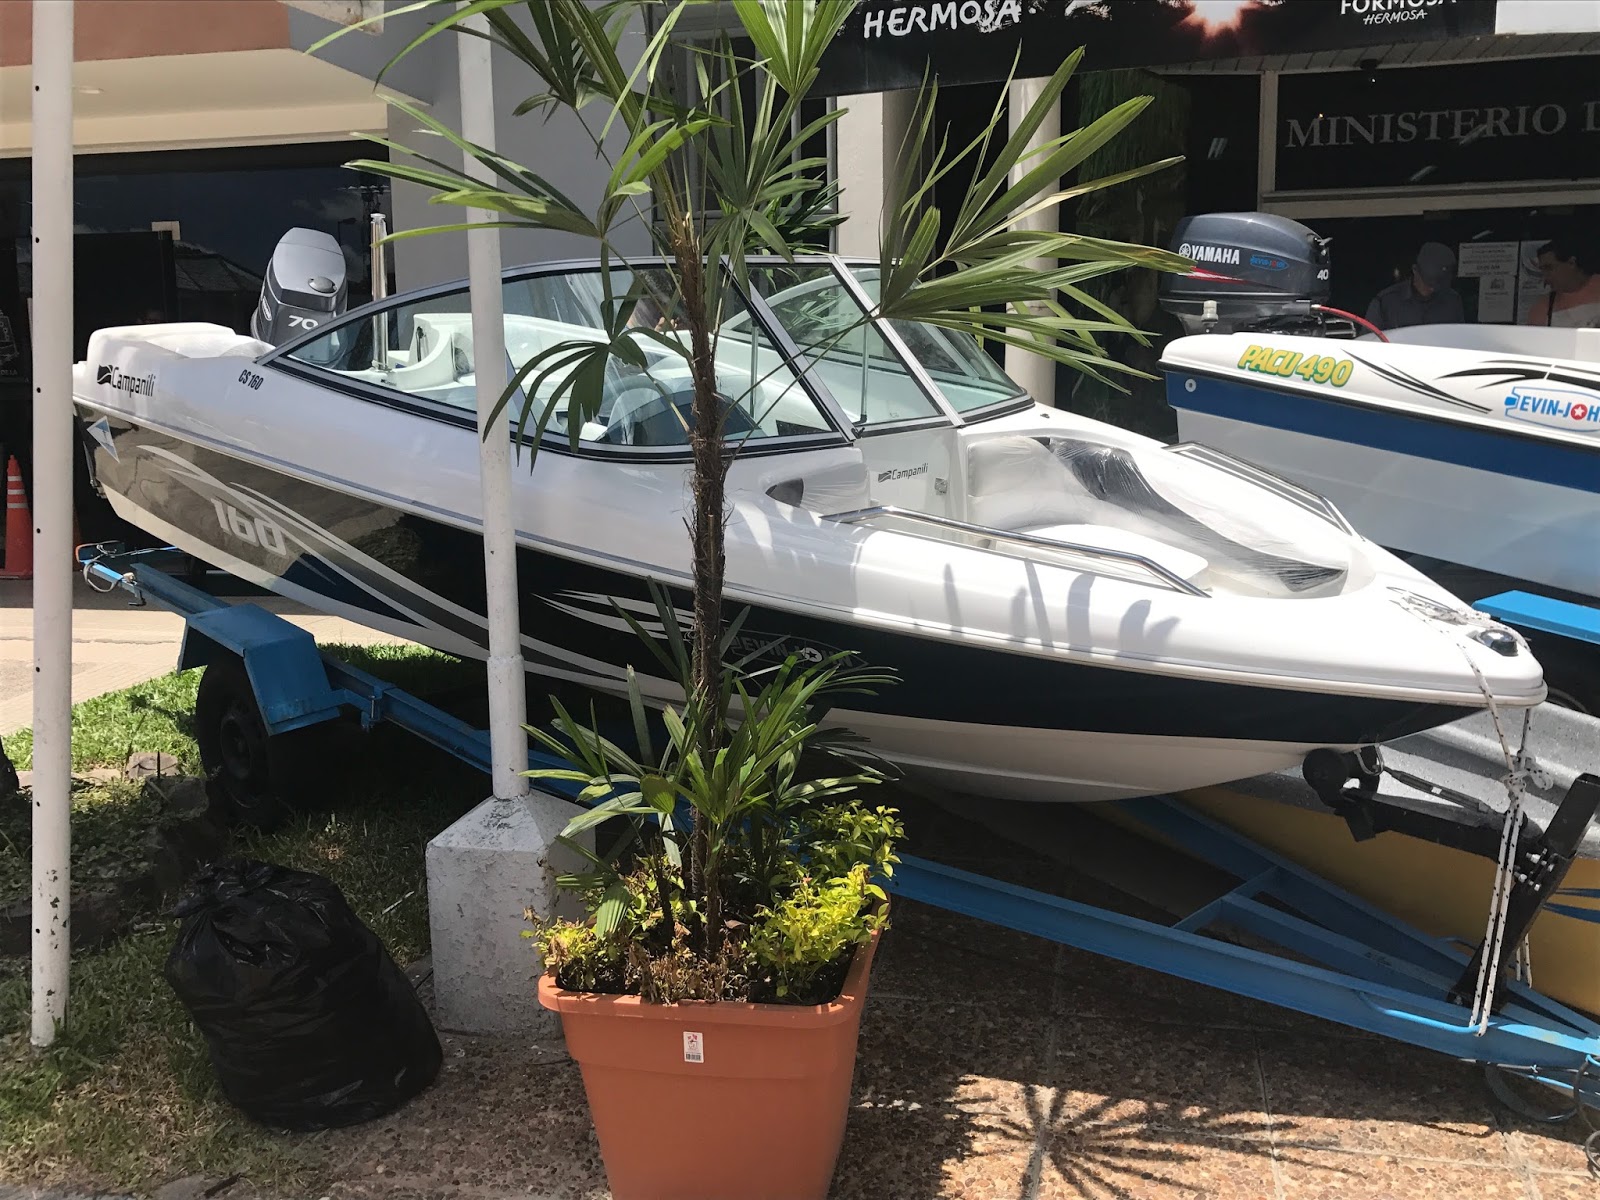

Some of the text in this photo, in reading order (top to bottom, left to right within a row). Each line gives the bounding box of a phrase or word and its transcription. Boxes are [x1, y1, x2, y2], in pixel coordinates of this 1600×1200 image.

[863, 0, 1022, 39] HERMOSA
[1362, 8, 1428, 25] HERMOSA
[1285, 103, 1567, 148] MINISTERIO
[1190, 244, 1240, 265] YAMAHA
[1316, 268, 1329, 281] 40
[287, 314, 319, 331] 70
[111, 365, 156, 398] Campanili
[238, 369, 264, 391] CS 160
[891, 462, 929, 480] Campanili
[210, 498, 287, 556] 160
